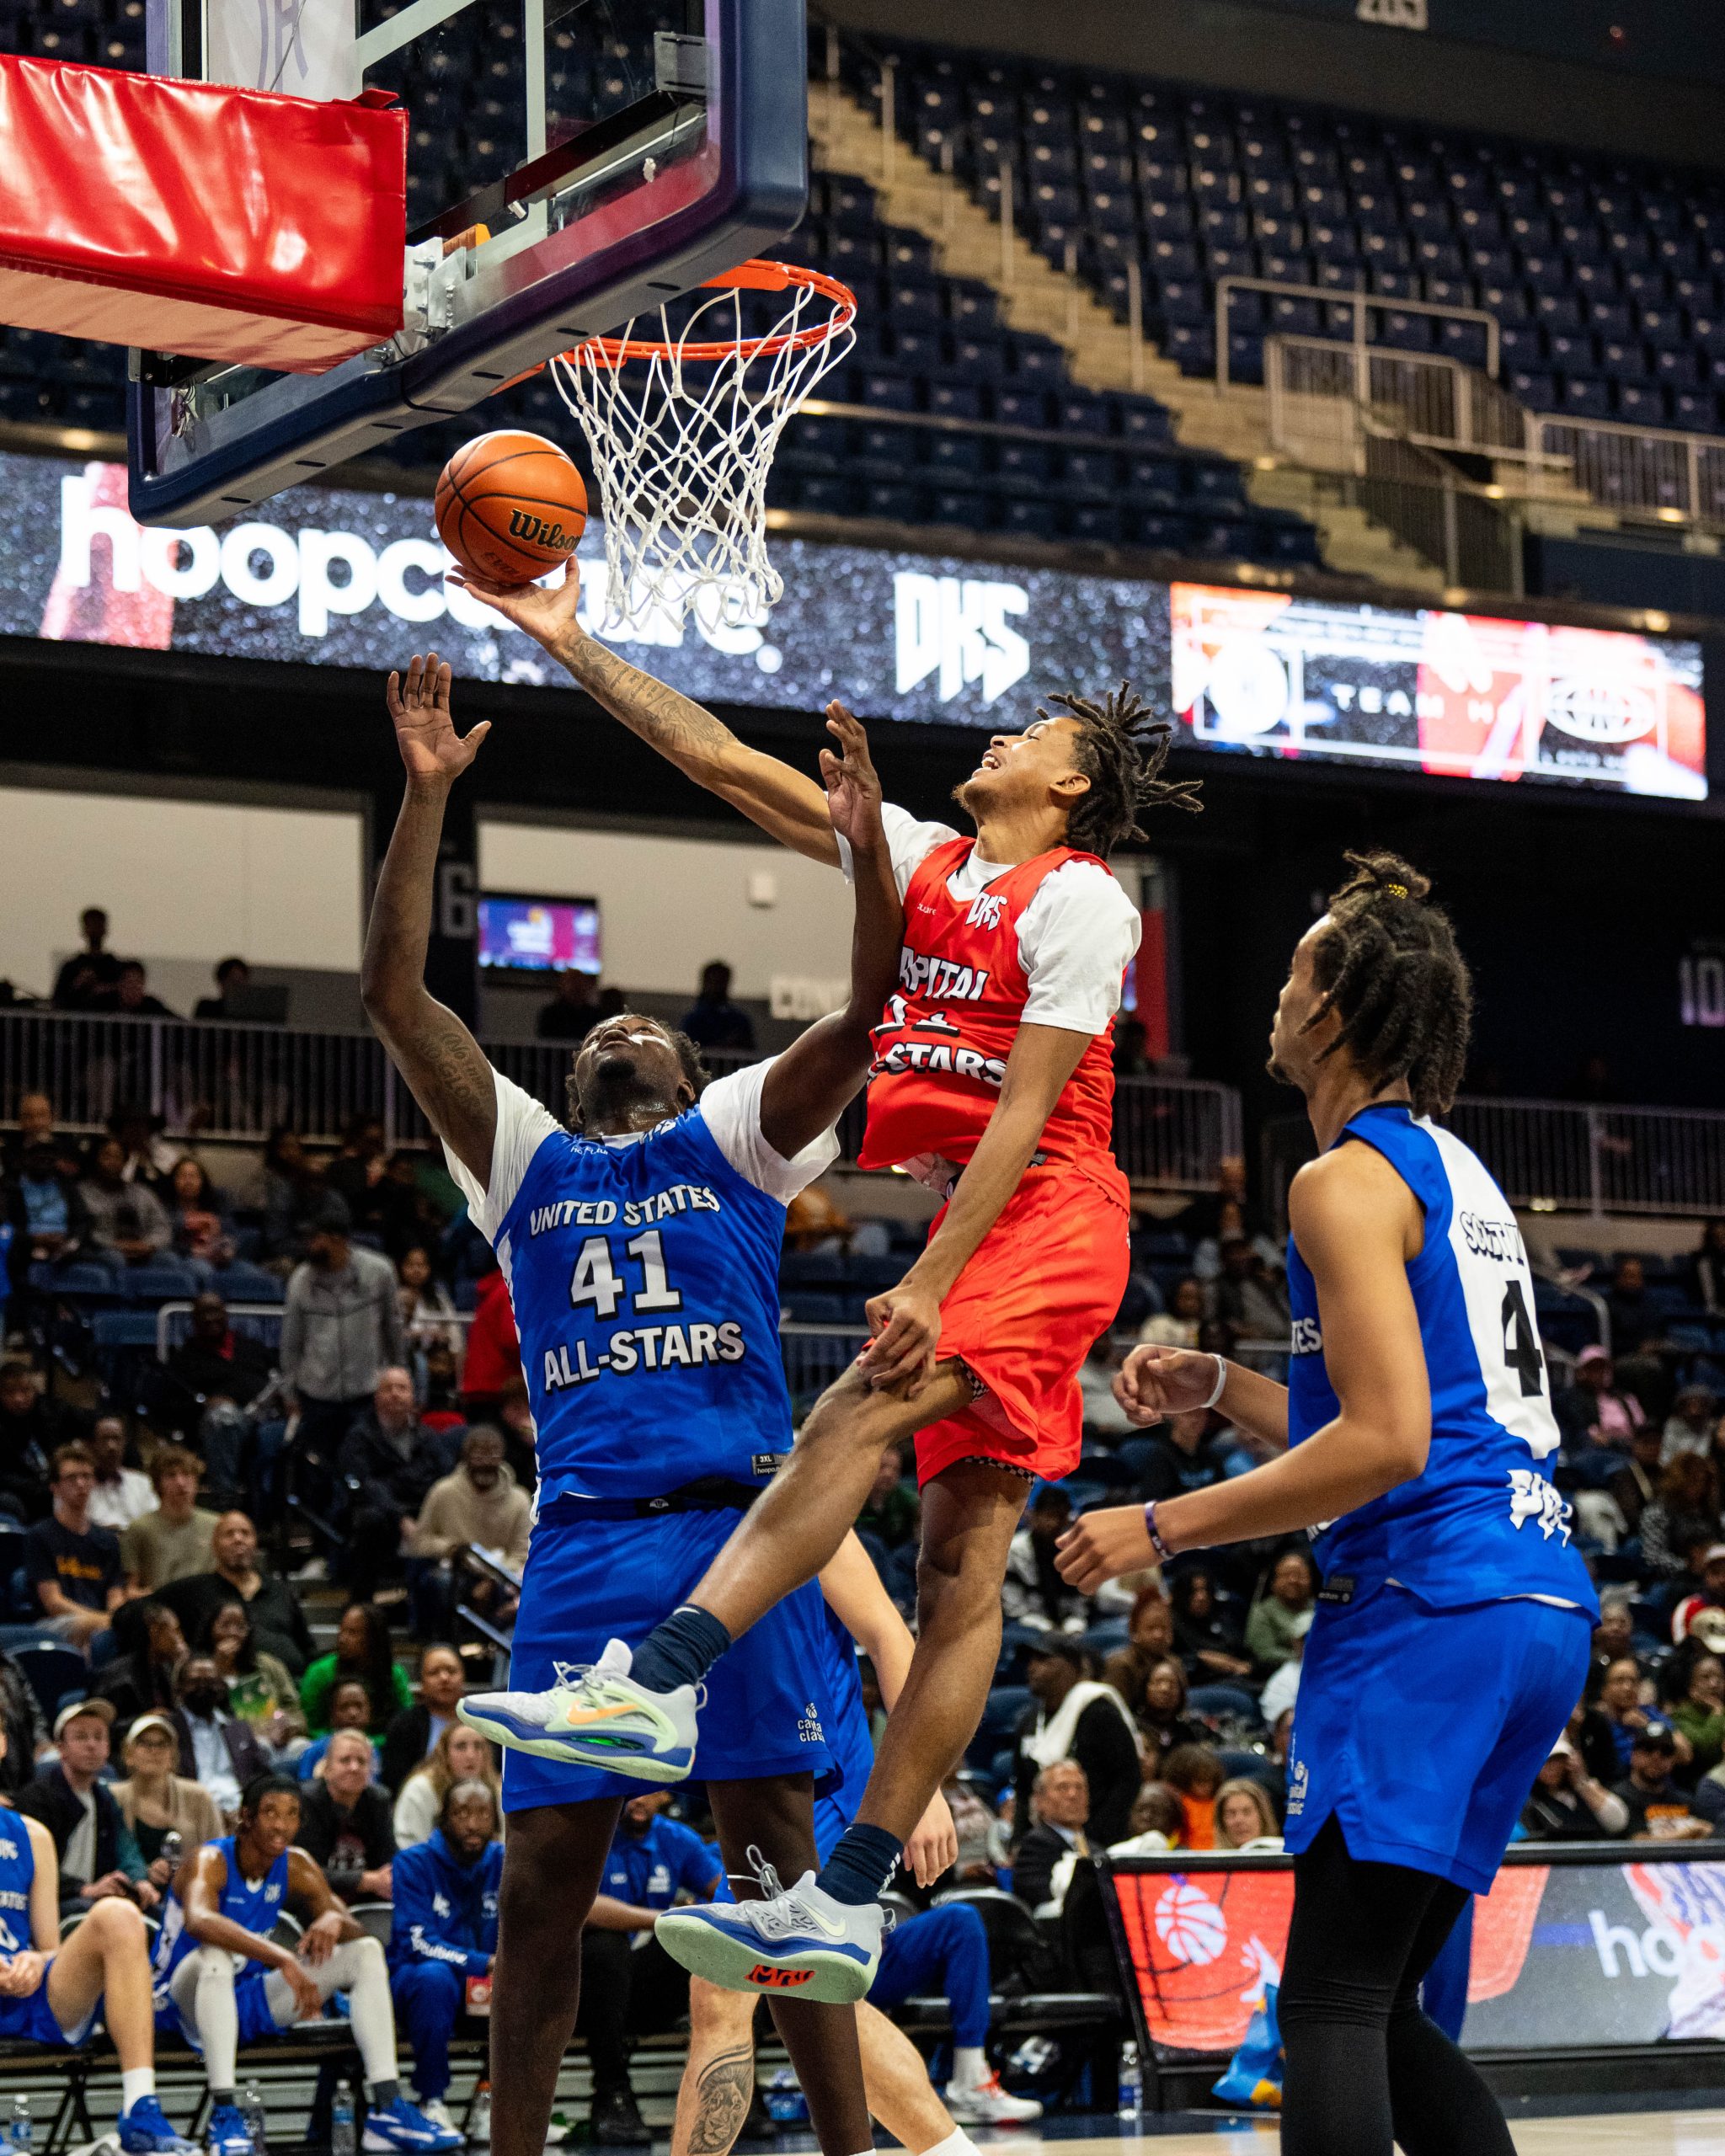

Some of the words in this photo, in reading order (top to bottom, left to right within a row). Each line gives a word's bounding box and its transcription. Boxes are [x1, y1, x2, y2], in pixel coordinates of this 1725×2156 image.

[893, 572, 1030, 704] DKS
[1330, 683, 1445, 718] TEAM
[964, 892, 1008, 931] DKS
[529, 1199, 618, 1238] UNITED
[622, 1183, 721, 1227] STATES
[569, 1229, 683, 1320] 41
[543, 1321, 748, 1394] ALL-STARS
[759, 1454, 772, 1464] 3XL
